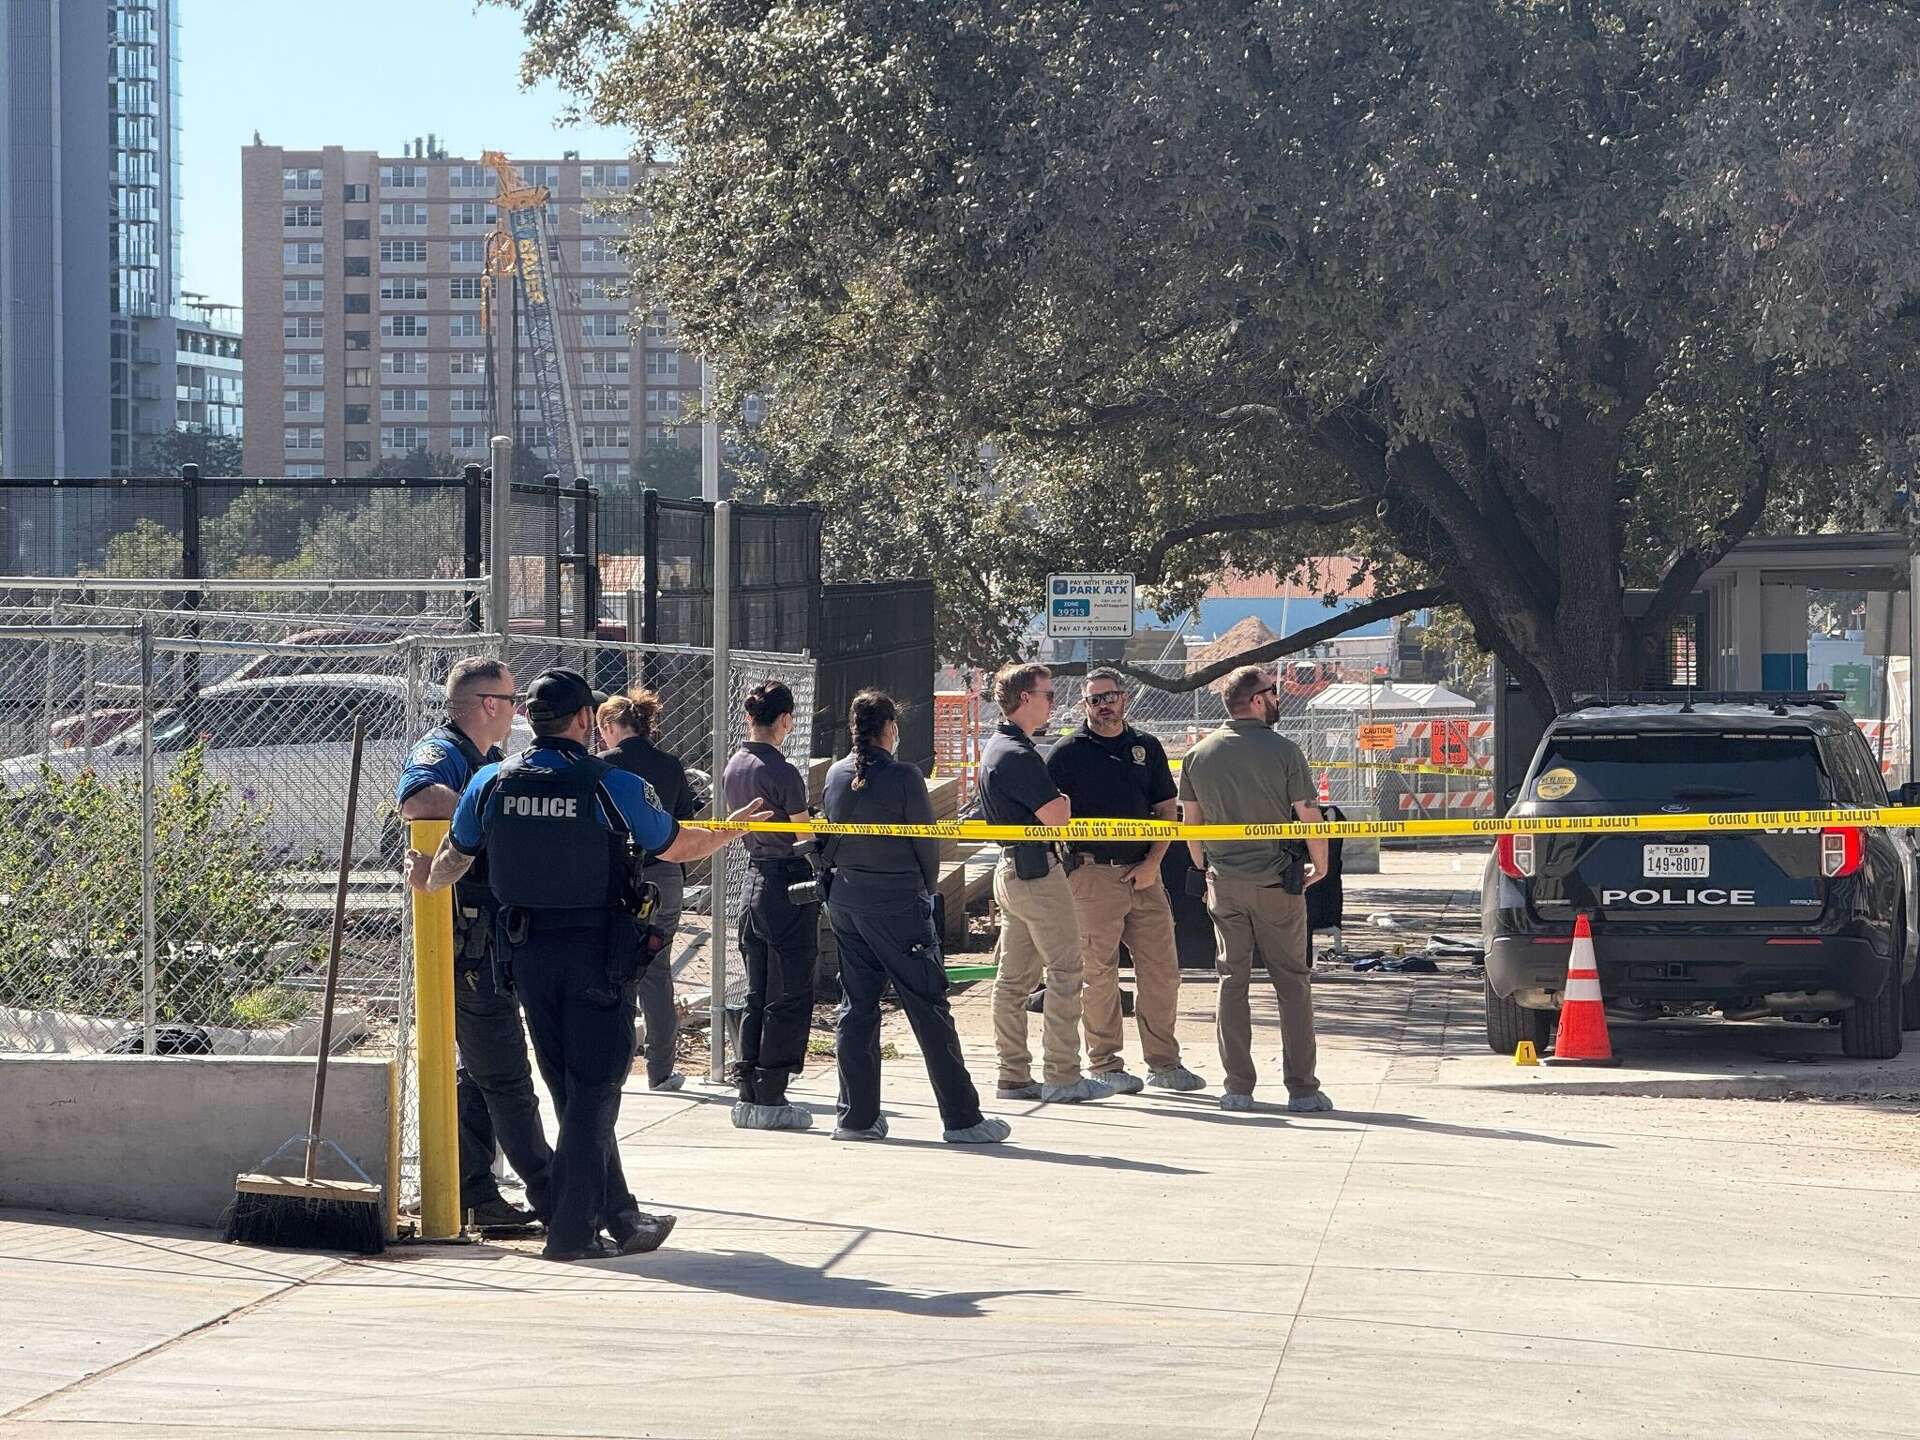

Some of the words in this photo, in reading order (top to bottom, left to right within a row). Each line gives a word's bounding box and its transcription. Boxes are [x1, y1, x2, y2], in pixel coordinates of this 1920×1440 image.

[1070, 586, 1100, 594] PARK
[1104, 586, 1127, 594] ATX
[1057, 608, 1085, 617] 39213
[503, 796, 577, 817] POLICE
[1602, 889, 1756, 905] POLICE
